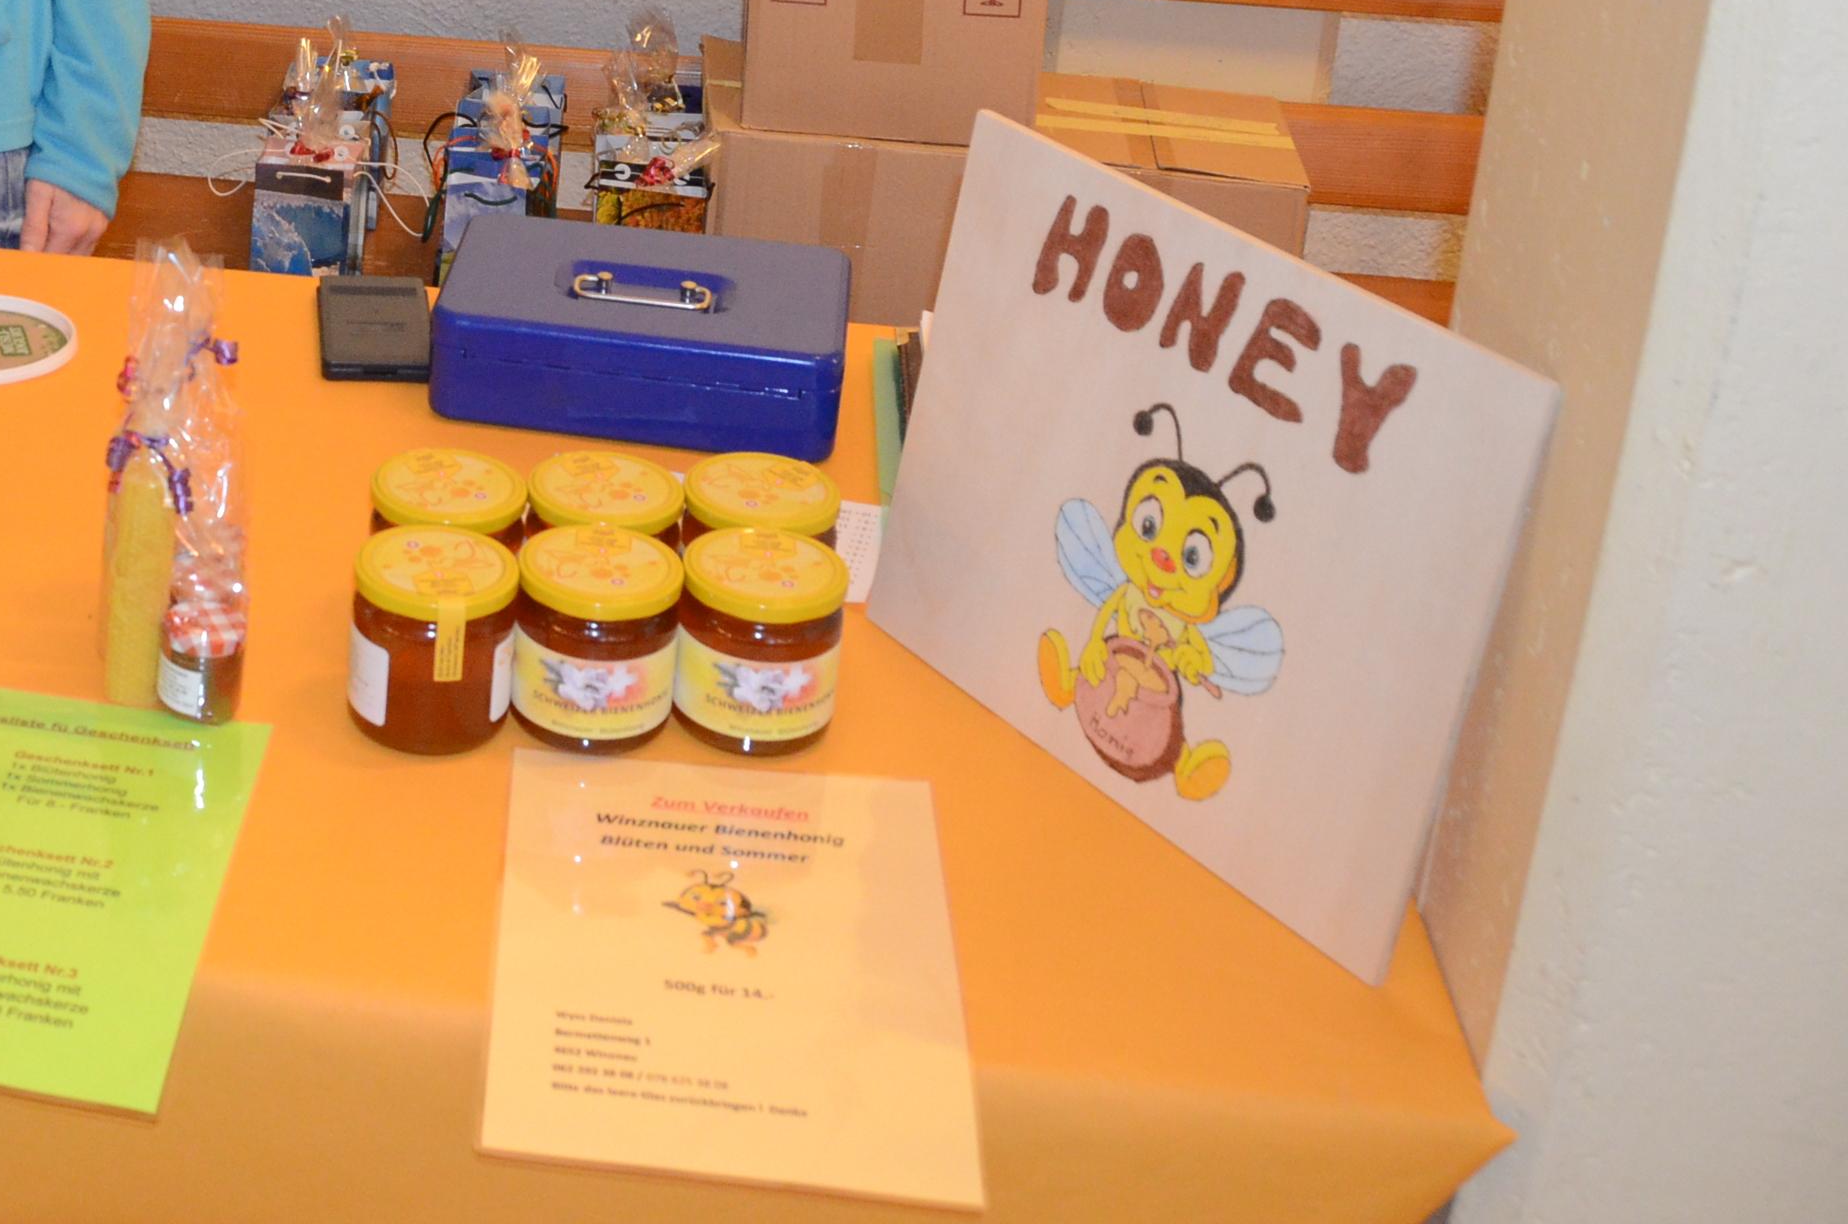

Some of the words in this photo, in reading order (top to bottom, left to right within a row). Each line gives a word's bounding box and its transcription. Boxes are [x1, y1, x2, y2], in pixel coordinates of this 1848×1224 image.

[1032, 194, 1419, 474] HONEY
[14, 750, 120, 774] Geschenksett
[25, 773, 127, 797] Sommerhonig
[16, 794, 41, 807] Für
[69, 801, 132, 819] Franken
[20, 783, 159, 812] Bienenwachskerze
[651, 796, 696, 812] Zum
[702, 800, 810, 822] Verkaufen
[596, 812, 707, 833] Winznauer
[714, 823, 844, 848] Bienenhonig
[600, 834, 668, 851] Blüten
[675, 841, 715, 855] und
[721, 845, 810, 864] Sommer
[80, 855, 114, 869] Nr.2
[76, 870, 100, 881] mit
[40, 890, 105, 908] Franken
[44, 963, 79, 979] Nr.3
[56, 983, 82, 996] mit
[663, 979, 706, 995] 500g
[711, 983, 736, 997] für
[6, 1006, 74, 1028] Franken
